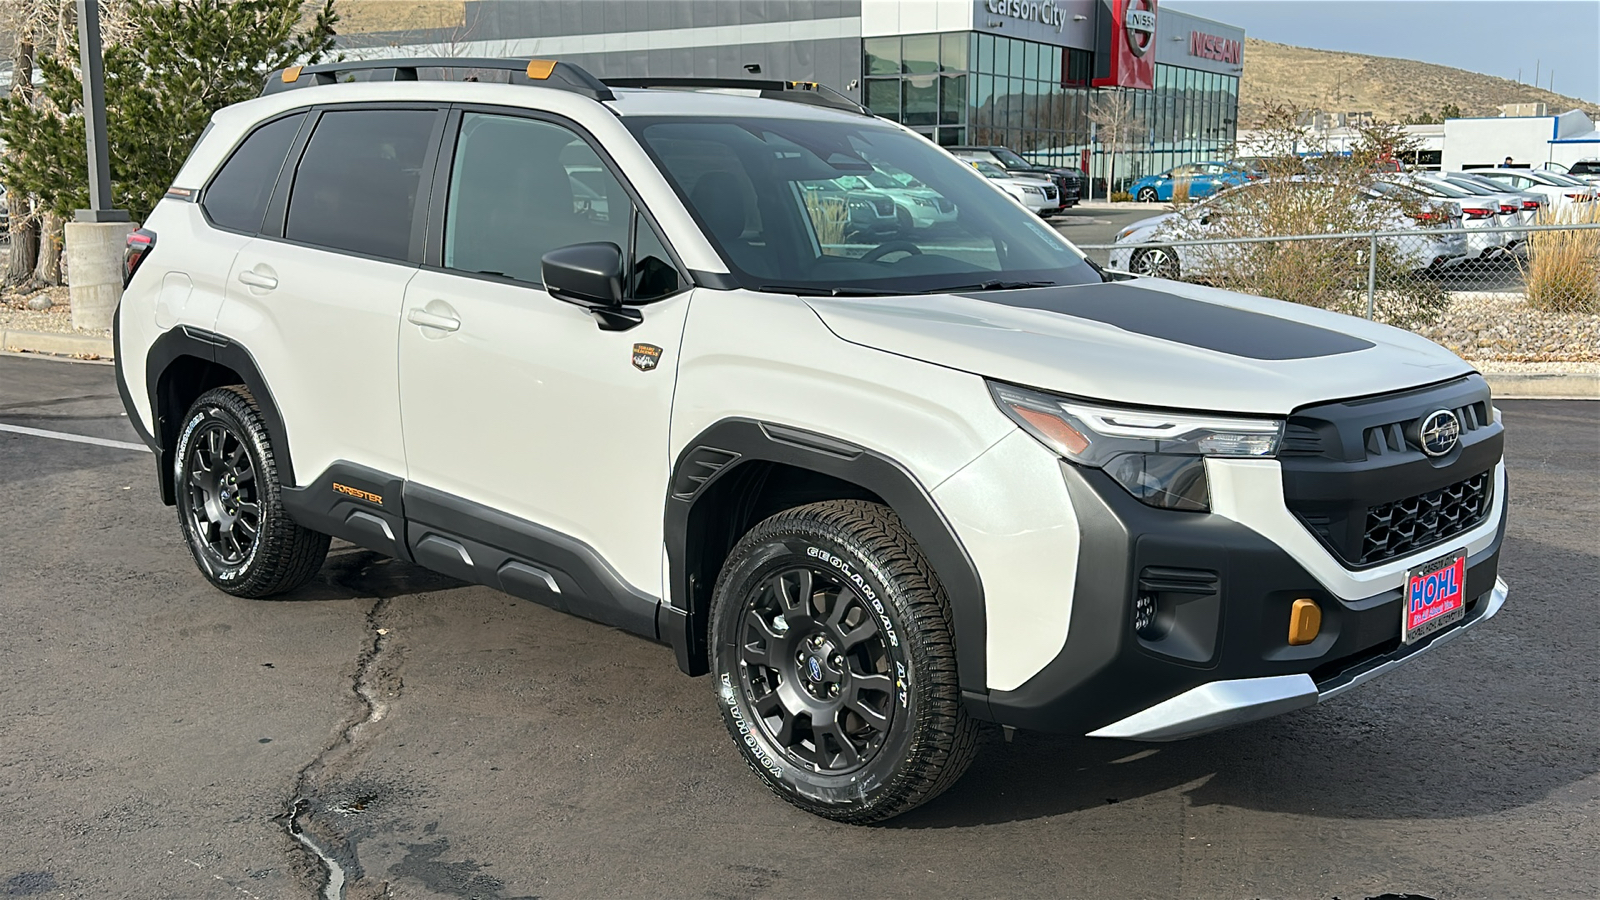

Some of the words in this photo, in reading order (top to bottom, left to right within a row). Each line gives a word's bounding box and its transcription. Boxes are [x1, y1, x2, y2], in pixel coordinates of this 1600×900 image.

[987, 0, 1038, 21] Carson
[1040, 3, 1066, 33] City
[1190, 30, 1241, 65] NISSAN
[333, 482, 383, 504] FORESTER
[1411, 567, 1458, 613] HOHL
[806, 546, 899, 648] GEOLANDAR
[896, 660, 908, 708] A/T
[720, 672, 784, 780] YOKOHAMA
